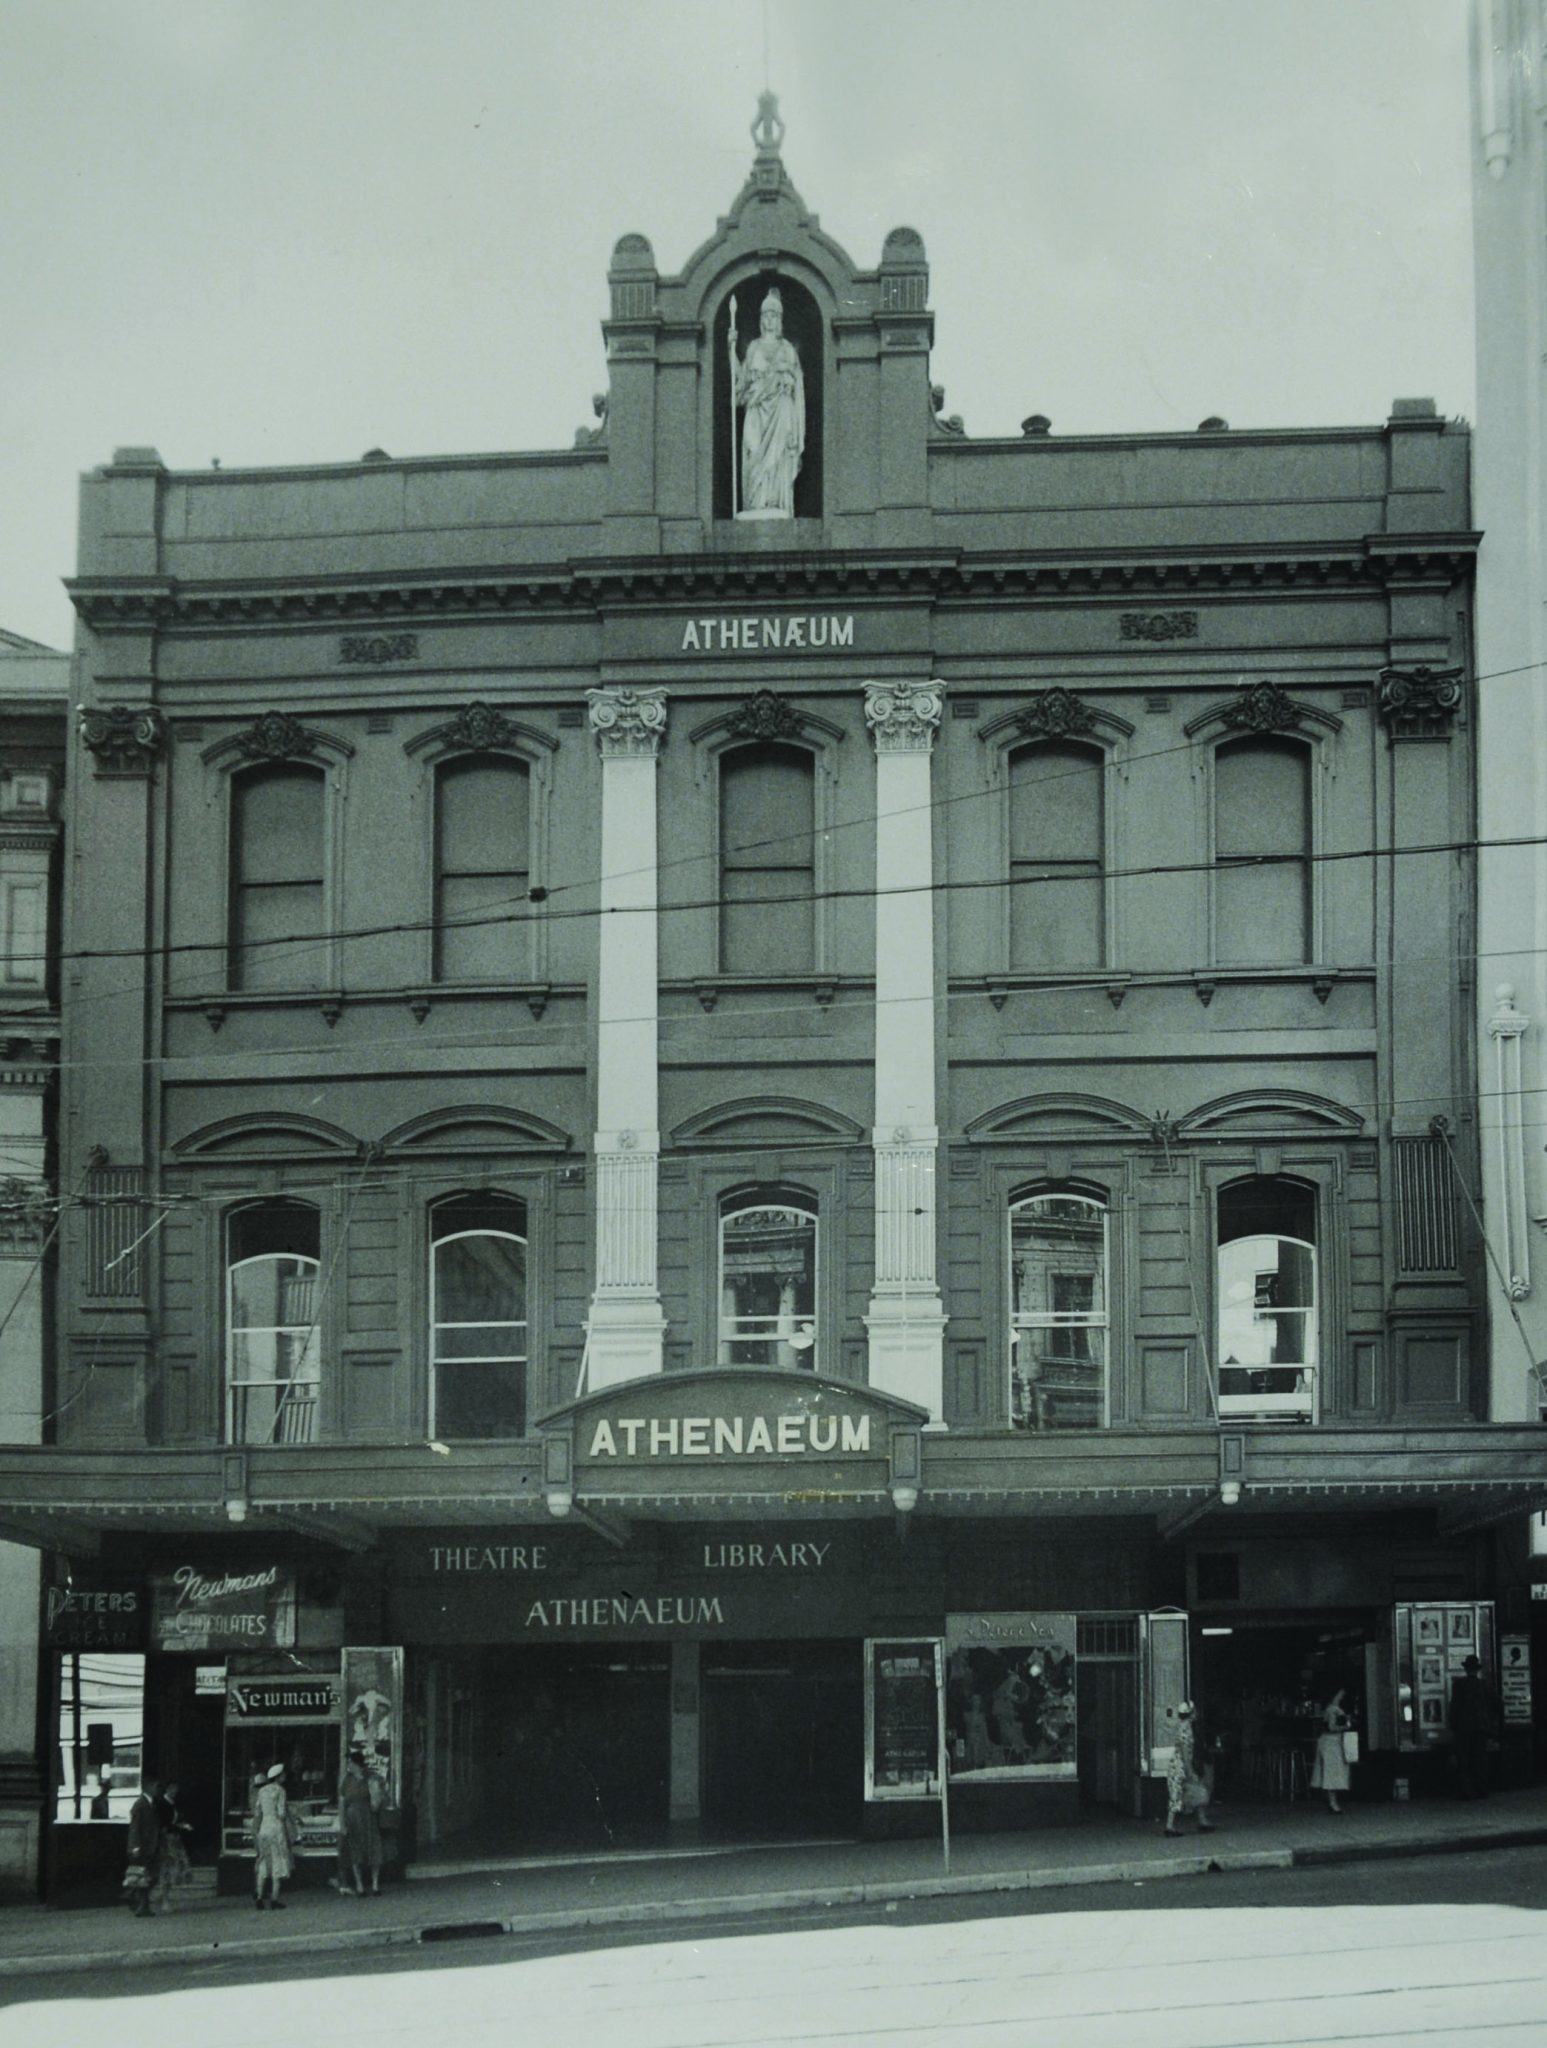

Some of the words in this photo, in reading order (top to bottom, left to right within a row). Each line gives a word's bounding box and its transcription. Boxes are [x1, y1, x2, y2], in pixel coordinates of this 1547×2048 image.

[682, 616, 854, 650] ATHENÆUM
[589, 1414, 871, 1457] ATHENAEUM
[429, 1546, 547, 1570] THEATRE
[704, 1543, 830, 1568] LIBRARY
[173, 1565, 277, 1609] Newmans
[175, 1609, 267, 1636] CHOCOLATES
[525, 1597, 724, 1627] ATHENAEUM
[229, 1685, 341, 1712] Newman's
